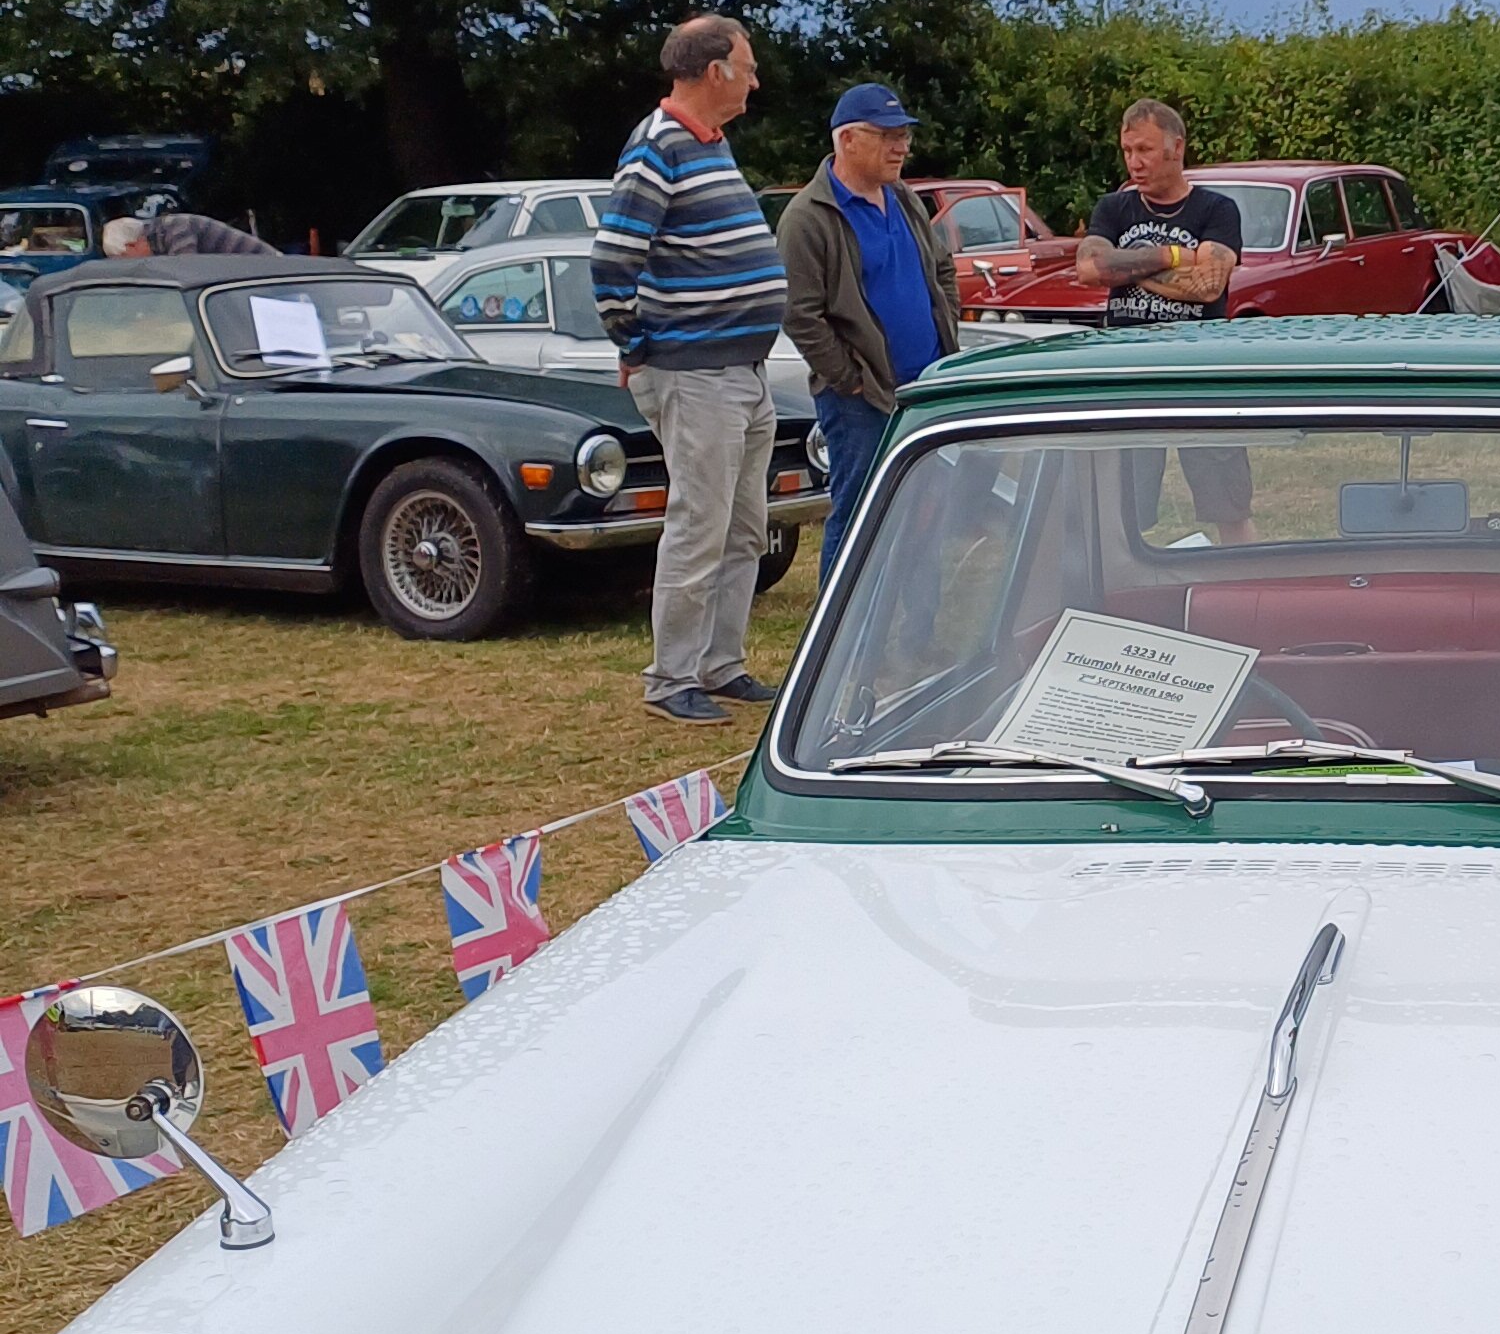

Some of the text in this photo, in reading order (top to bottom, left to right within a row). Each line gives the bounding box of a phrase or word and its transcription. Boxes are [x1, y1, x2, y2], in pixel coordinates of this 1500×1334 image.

[1118, 221, 1200, 250] RIGINAL BOD
[1151, 299, 1204, 317] ENGINE
[1122, 644, 1158, 659] 4323
[1063, 651, 1215, 693] Triumph Herald Coupe
[1095, 675, 1157, 698] SEPTEMBER
[1159, 690, 1185, 703] 1960
